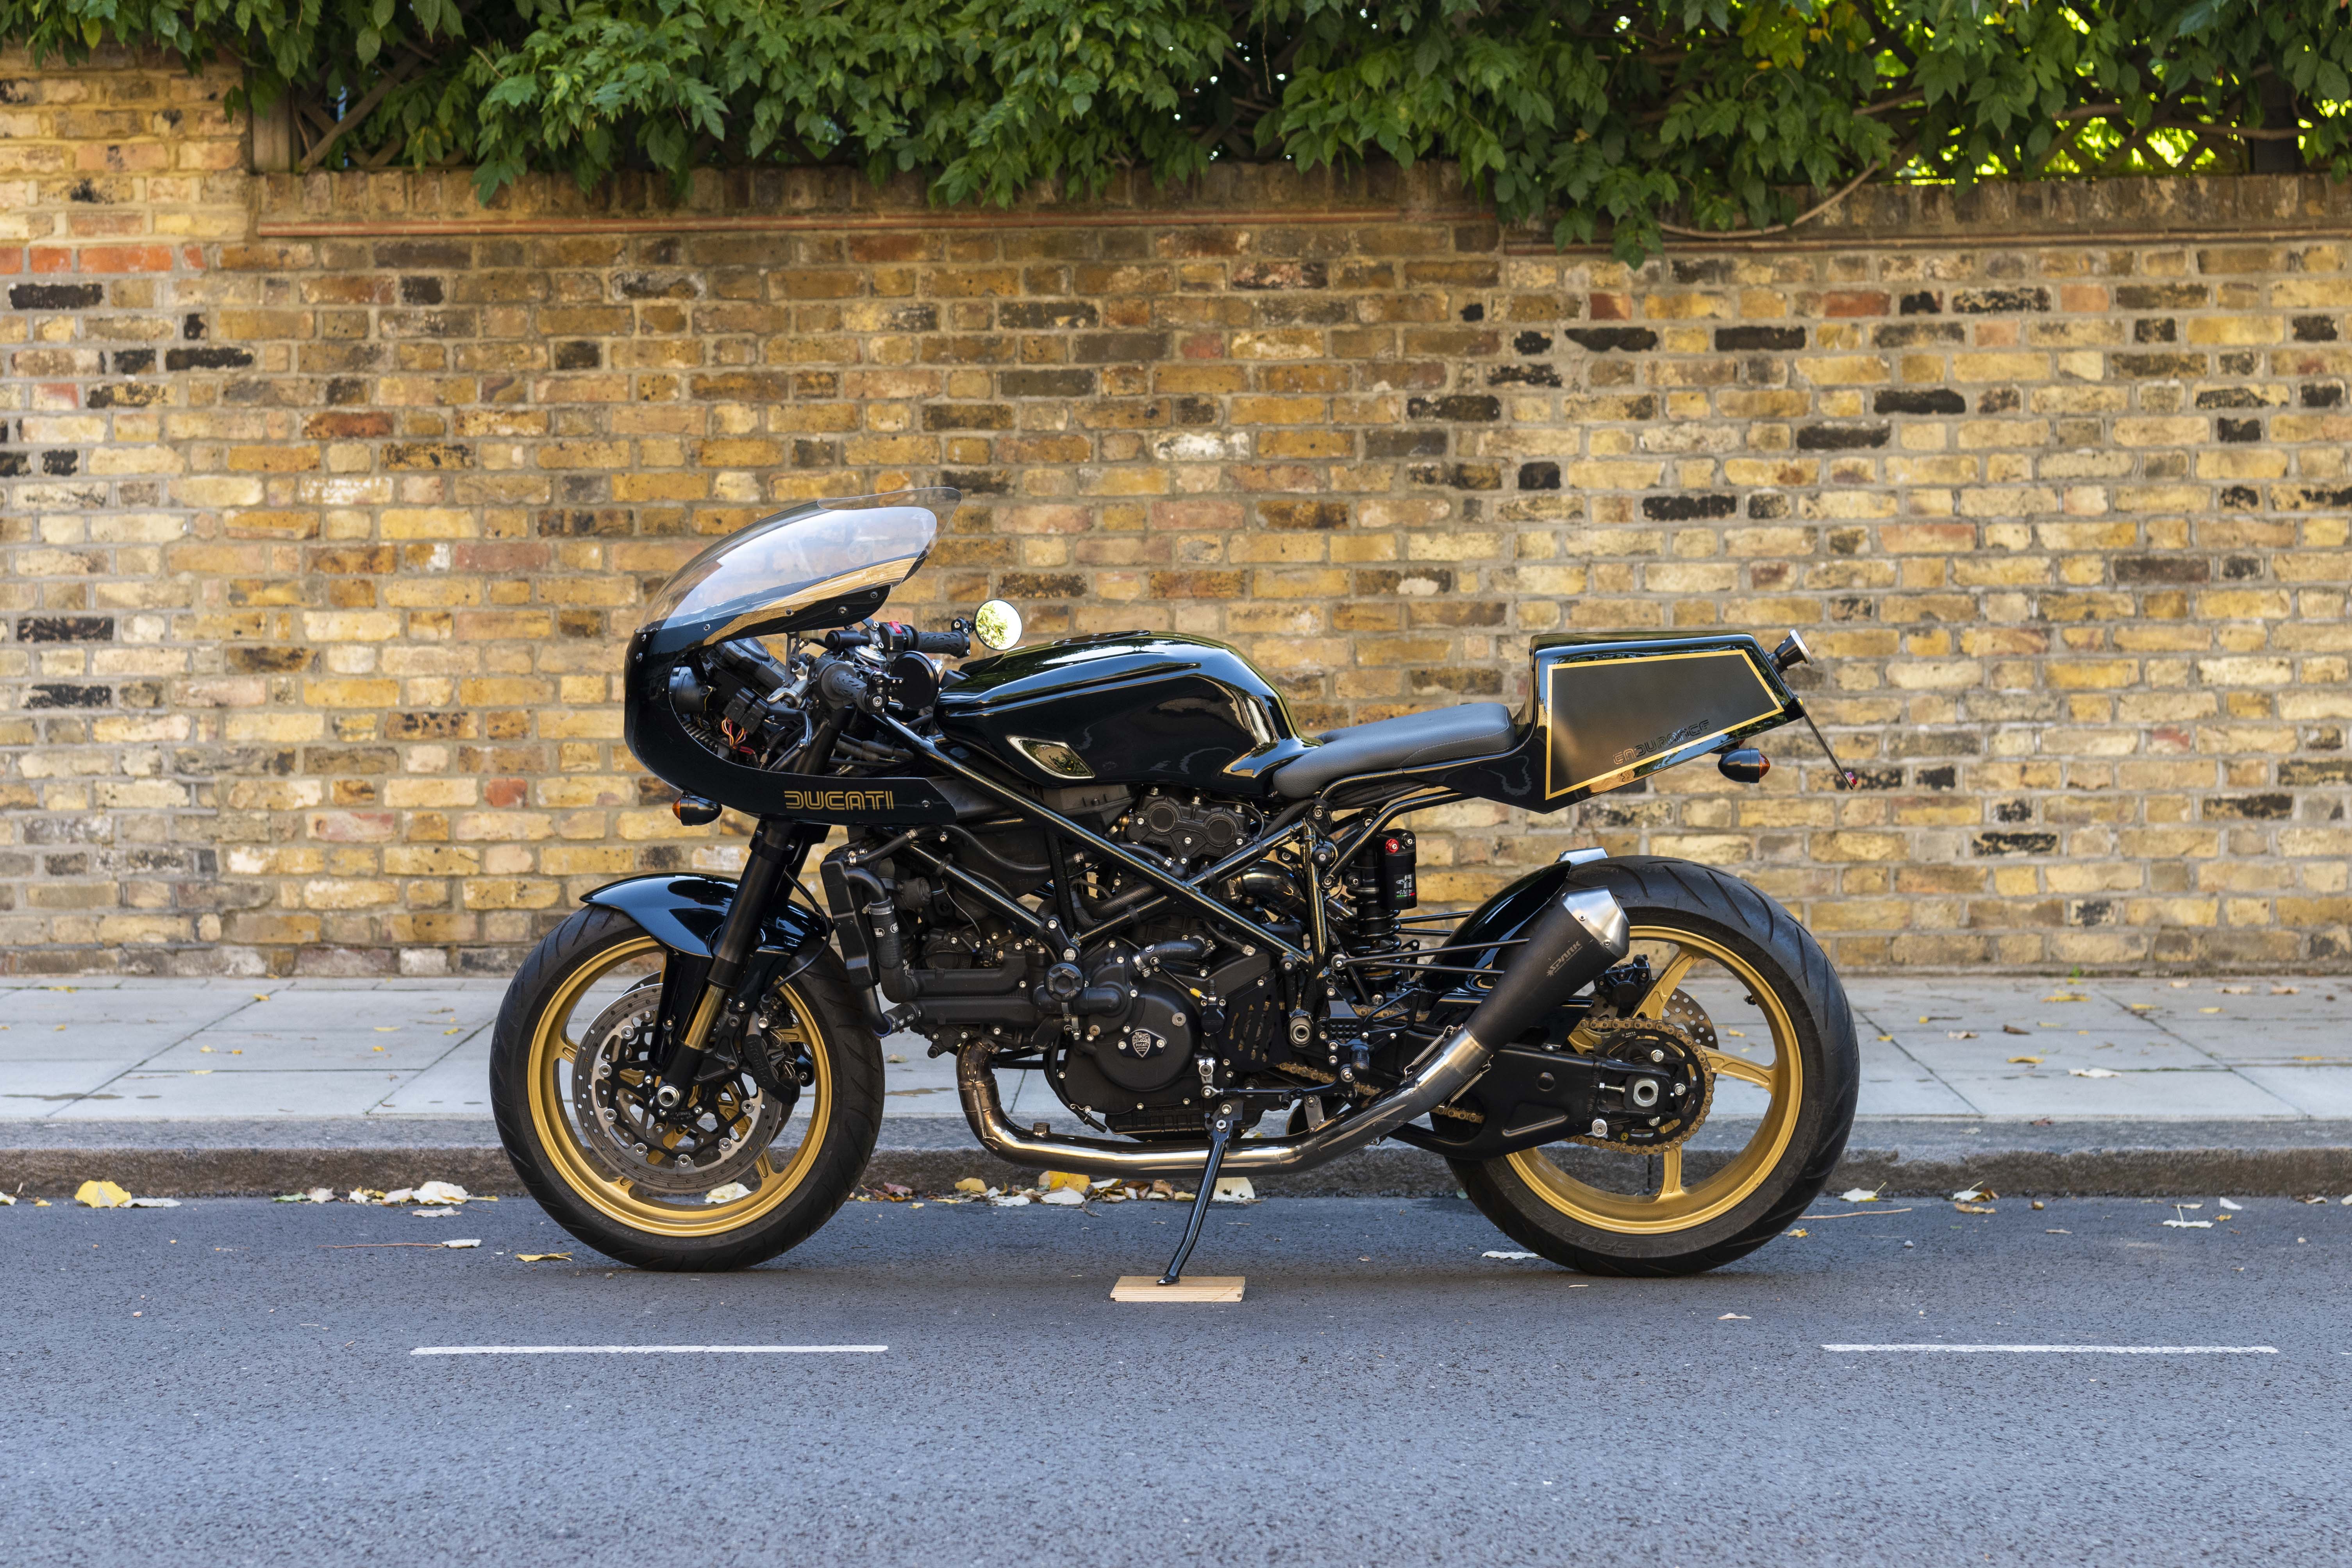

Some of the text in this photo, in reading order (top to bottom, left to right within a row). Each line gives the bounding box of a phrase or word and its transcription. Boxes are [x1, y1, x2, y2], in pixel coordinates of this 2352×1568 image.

[1613, 720, 1710, 764] ENDURANCE
[784, 791, 894, 810] DUCATI
[1550, 940, 1581, 972] SPARK
[748, 1040, 769, 1082] brembo
